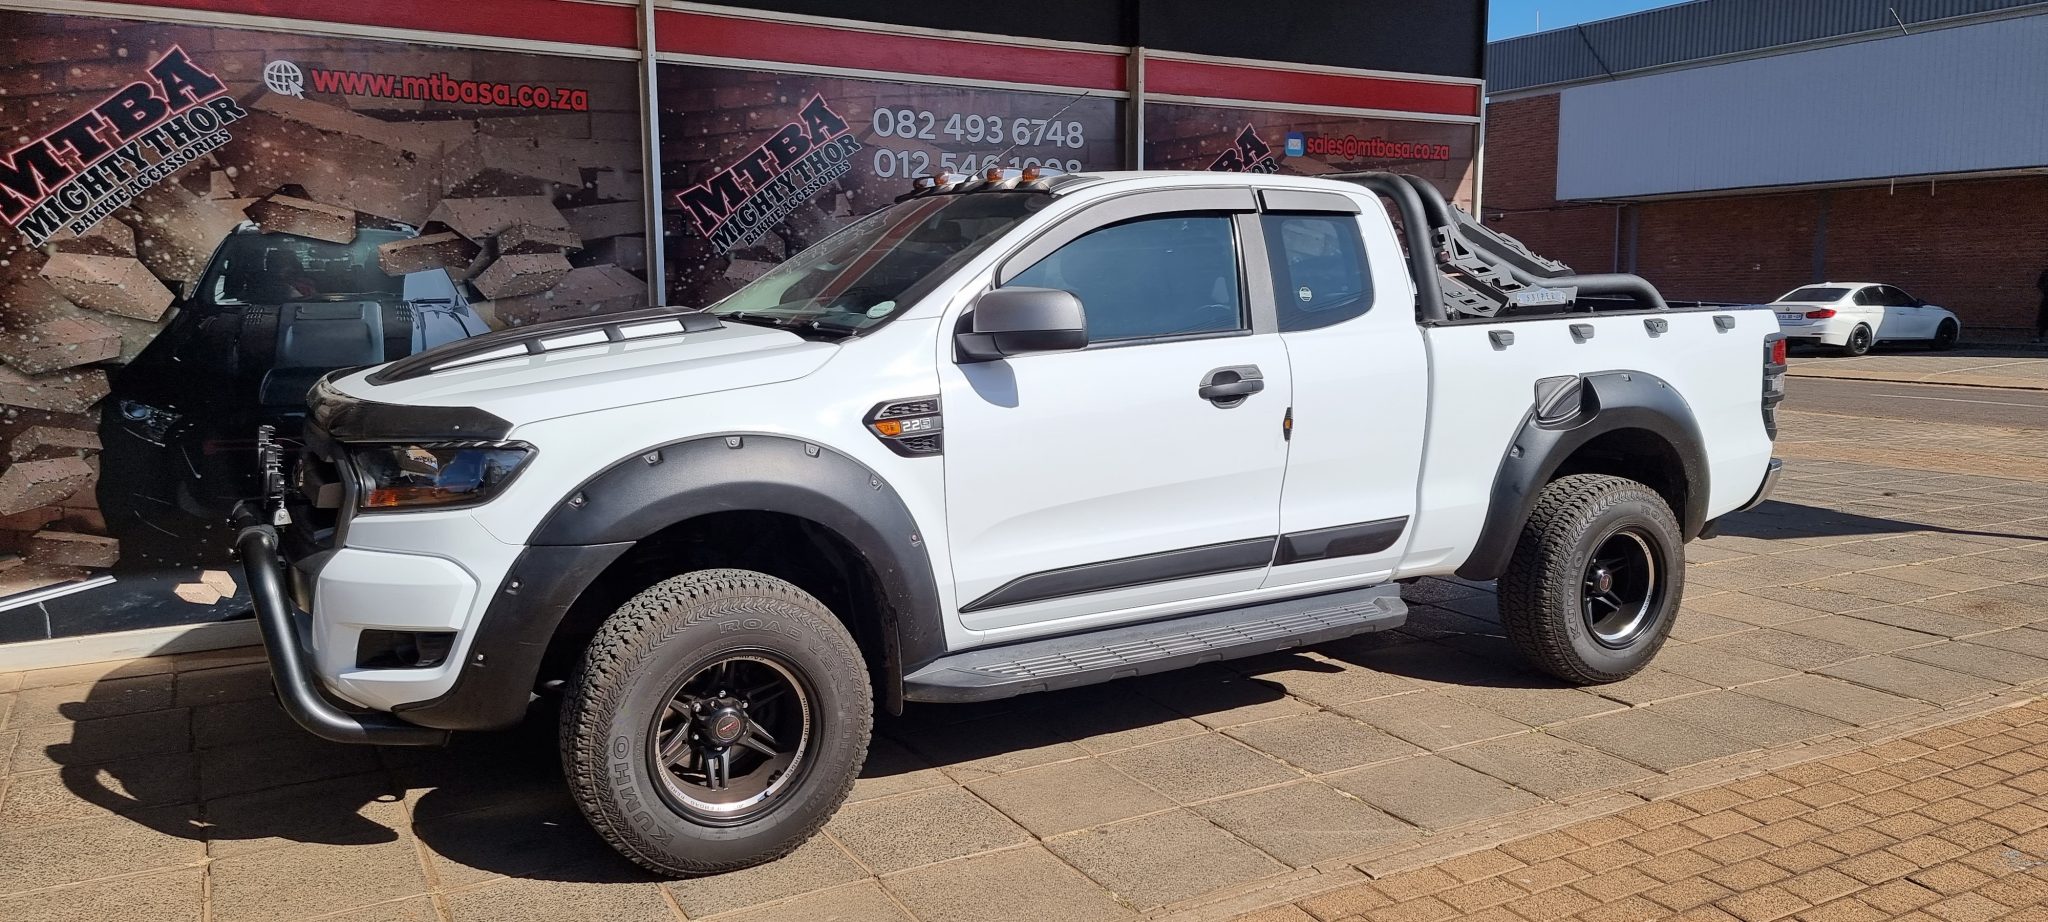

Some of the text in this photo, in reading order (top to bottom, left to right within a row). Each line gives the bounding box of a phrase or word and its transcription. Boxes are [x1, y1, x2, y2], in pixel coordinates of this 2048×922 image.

[0, 44, 229, 225] MTBA
[312, 68, 588, 111] www.mtbasa.co.za
[873, 107, 1084, 149] 082 493 6748
[16, 96, 248, 248] MIGHTY THOR
[68, 129, 232, 237] BAKKIE ACCESSORIES
[676, 92, 850, 237] MTBA
[710, 134, 862, 255] MIGHTY THOR
[874, 149, 931, 179] 012
[1307, 133, 1449, 161] sales@mtbasa.co.za
[743, 160, 852, 247] BAKKIE ACCESSORIES
[718, 618, 803, 641] ROAD
[613, 735, 675, 847] KUMHO
